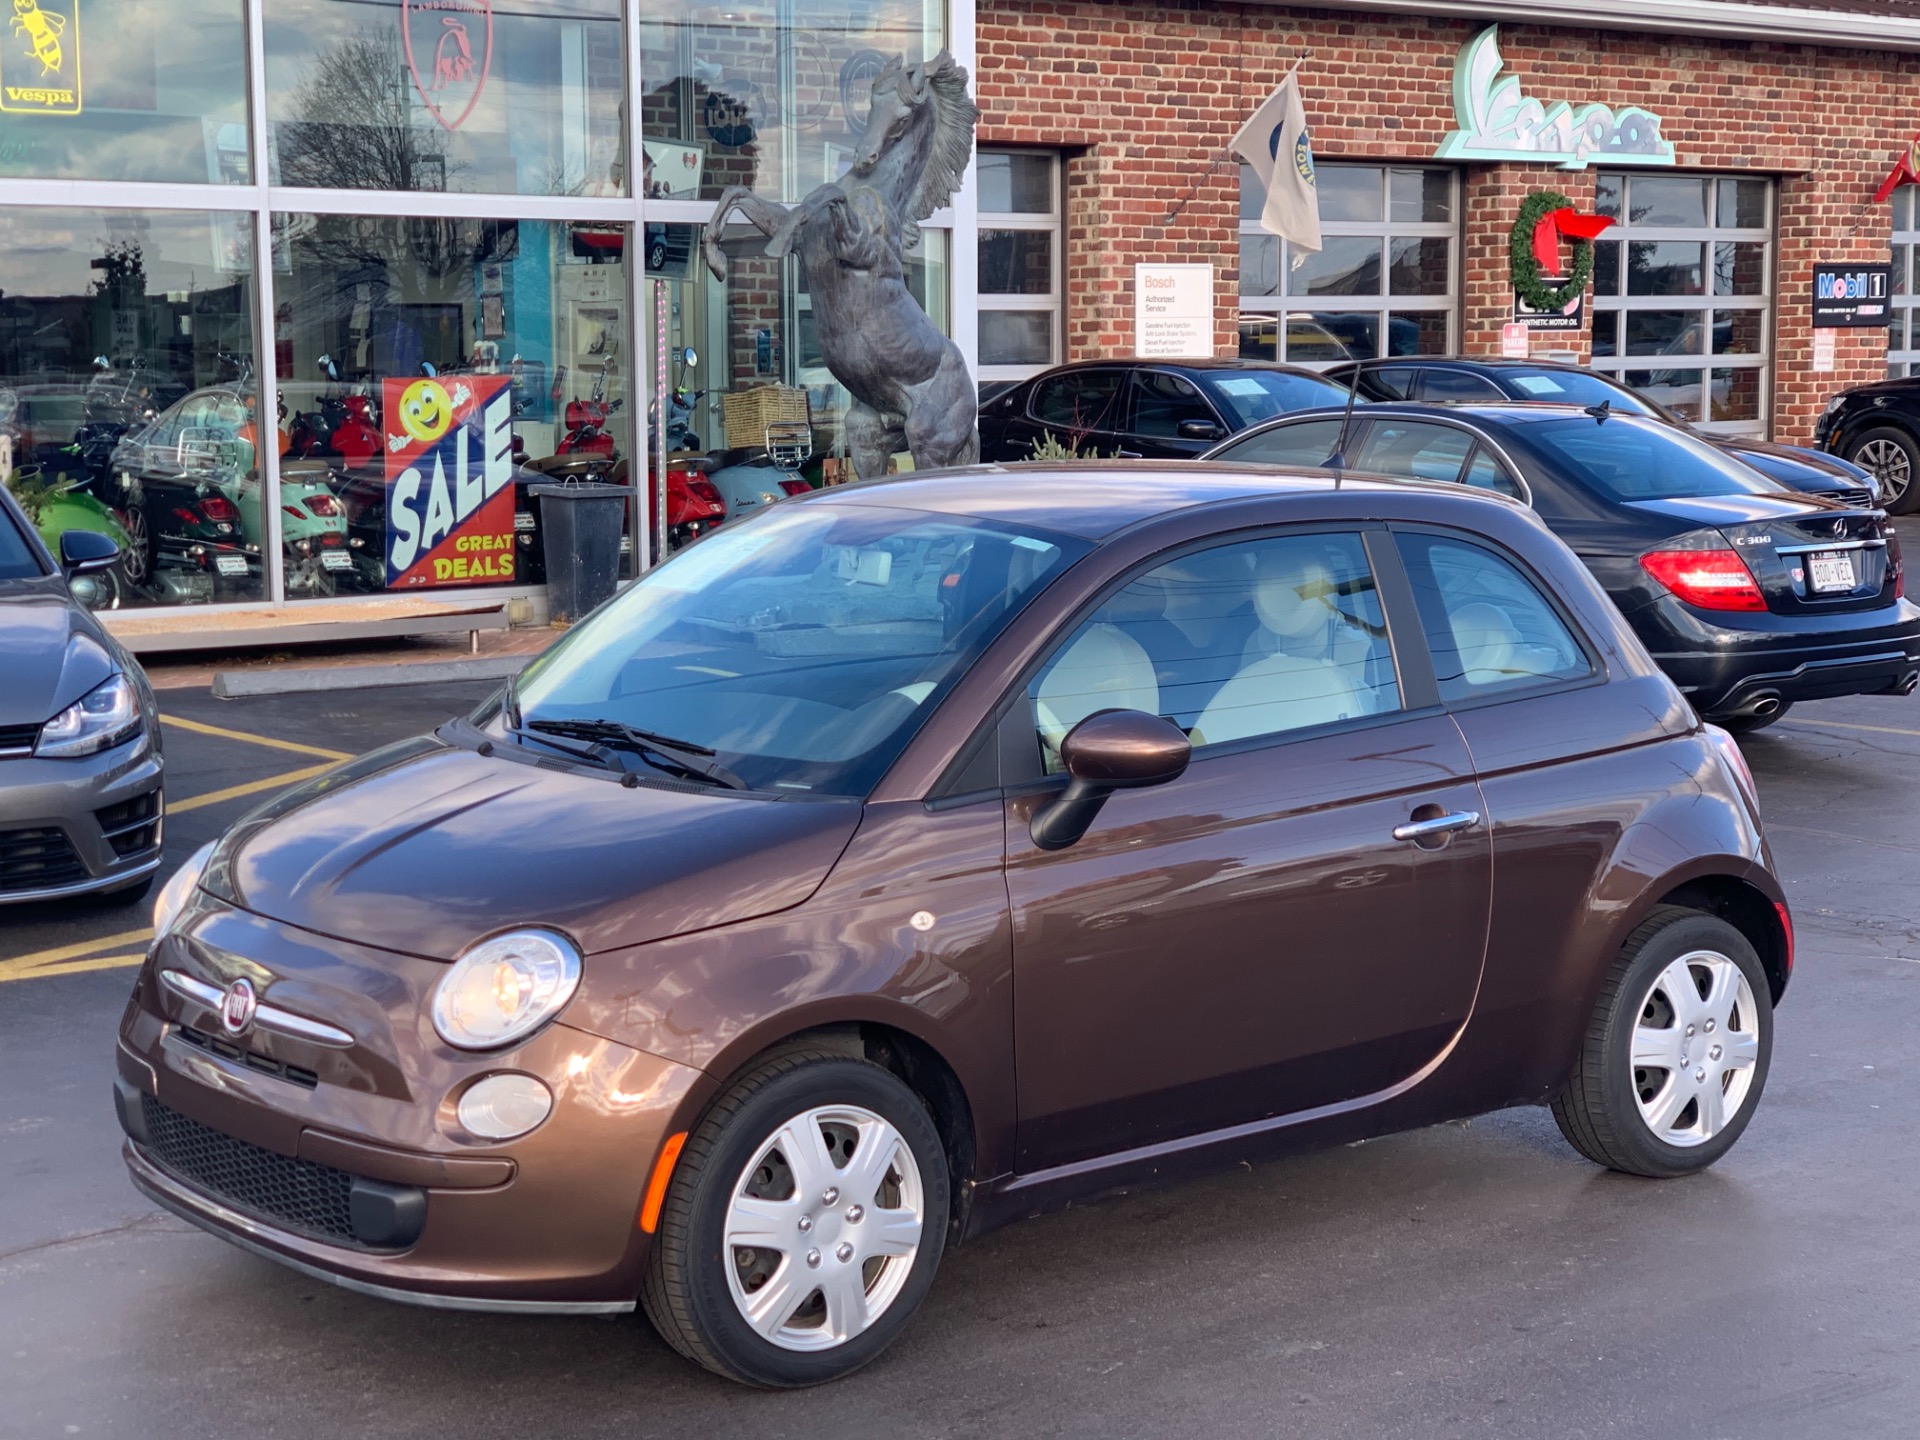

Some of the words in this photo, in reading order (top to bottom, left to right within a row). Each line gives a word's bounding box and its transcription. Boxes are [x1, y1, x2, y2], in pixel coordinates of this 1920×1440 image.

[5, 87, 74, 106] Vespa
[1460, 25, 1671, 163] Vespa
[1145, 275, 1175, 288] Bosch
[1818, 273, 1867, 299] Mobil
[1145, 295, 1175, 303] Authorized
[1145, 304, 1166, 312] Service
[391, 389, 513, 571] SALE
[455, 534, 513, 552] GREAT
[1736, 538, 1745, 546] C
[1747, 535, 1772, 545] 300
[433, 553, 513, 580] DEALS
